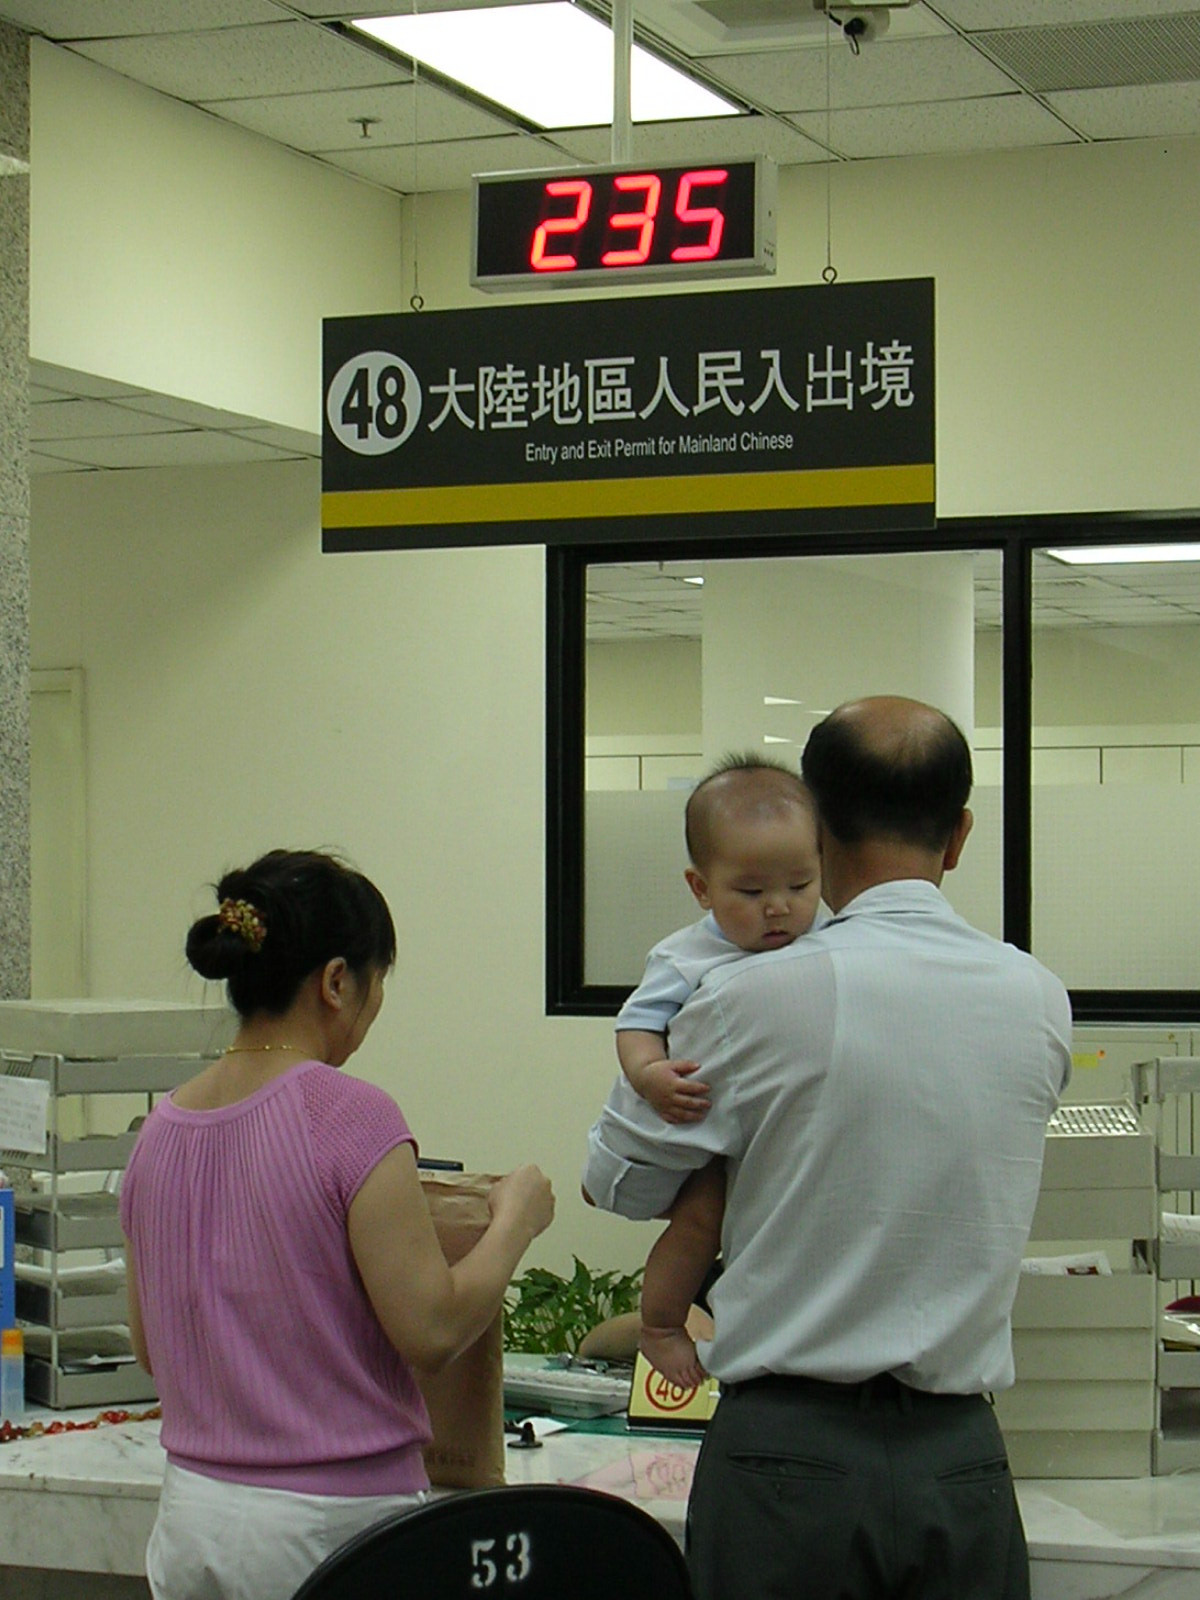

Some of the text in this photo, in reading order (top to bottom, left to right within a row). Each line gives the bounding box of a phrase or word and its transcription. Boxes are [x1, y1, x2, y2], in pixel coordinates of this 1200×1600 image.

[529, 168, 729, 272] 235
[341, 339, 915, 440] 48 大陸地區人民入出境
[525, 431, 794, 465] Entry and Exit Permit for Mainland Chinese
[470, 1532, 532, 1588] 53
